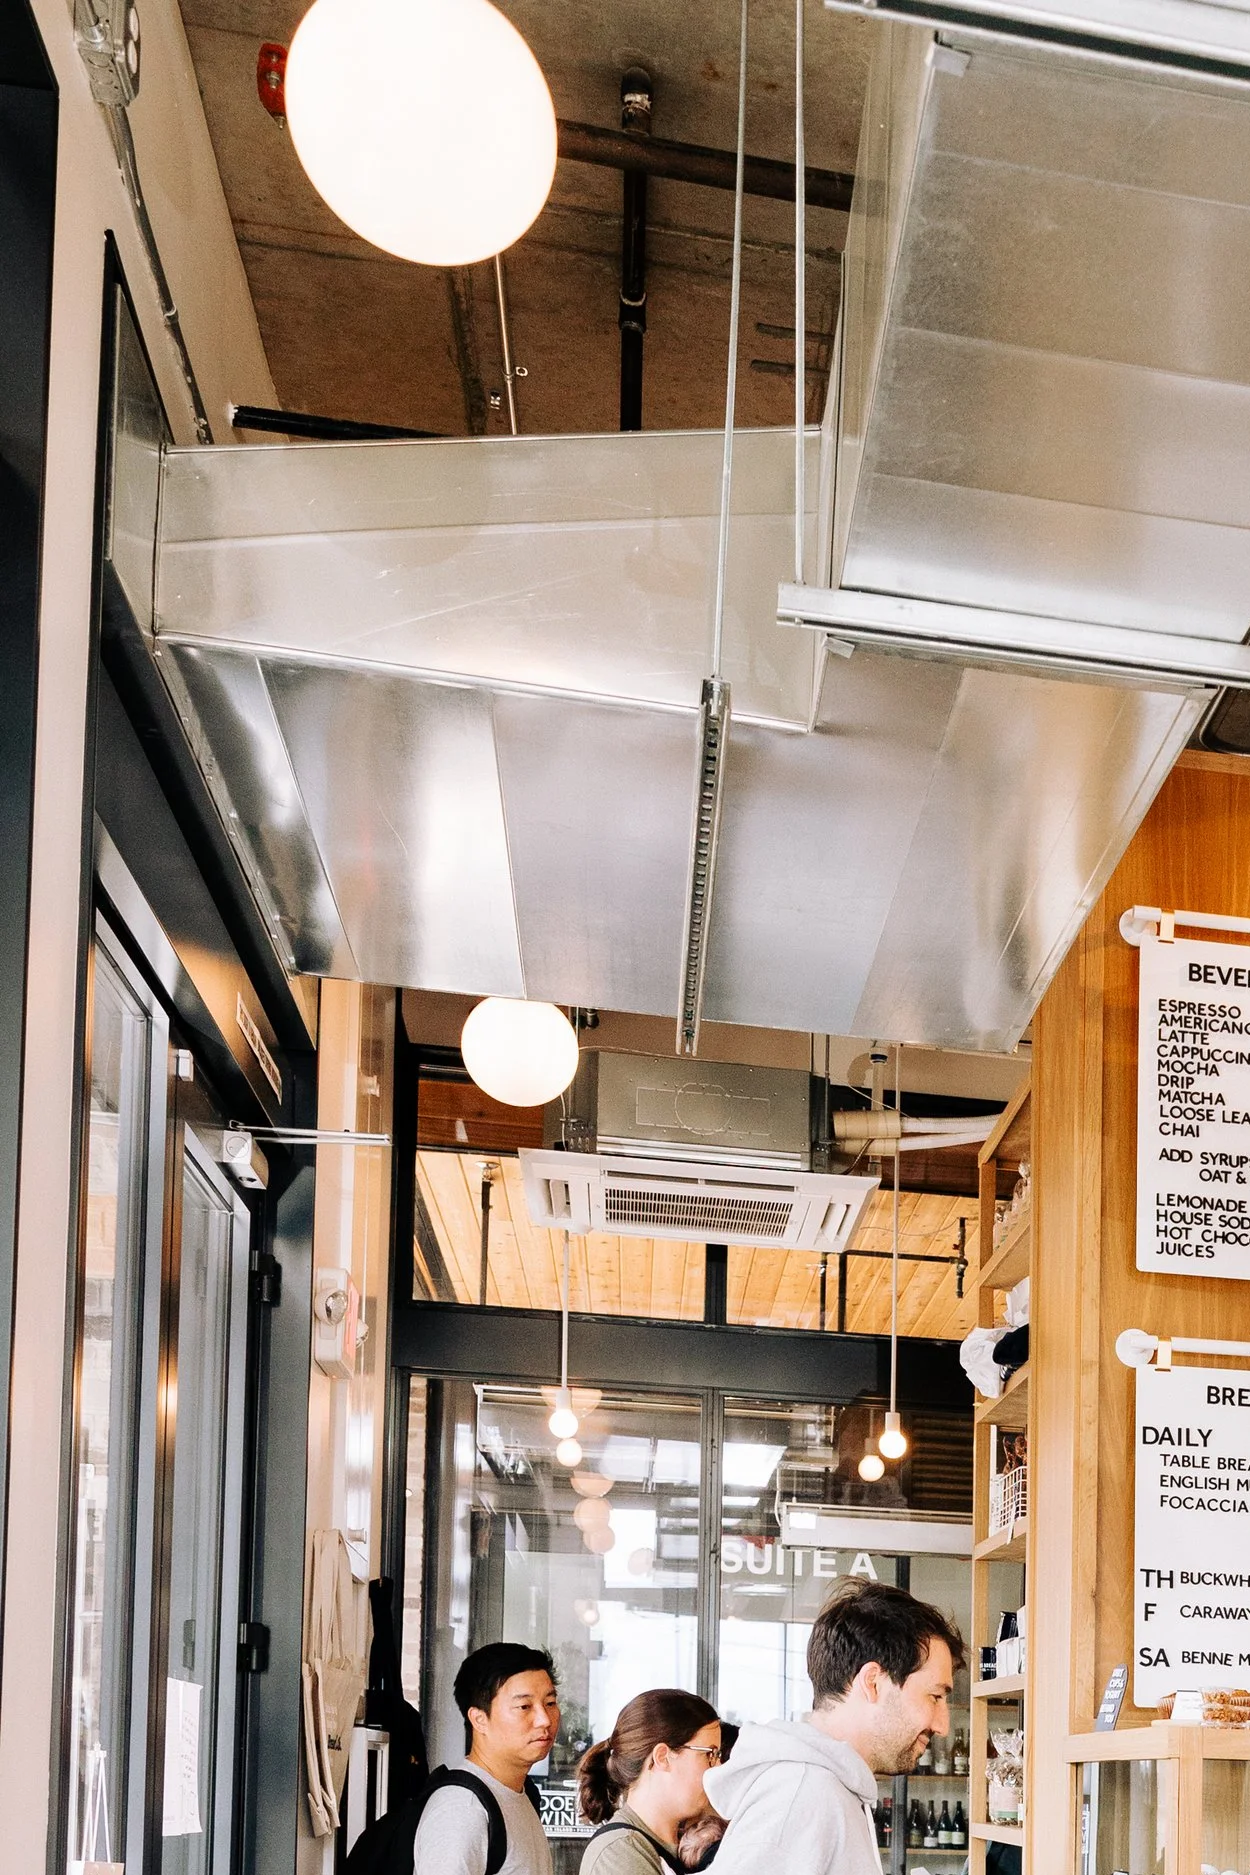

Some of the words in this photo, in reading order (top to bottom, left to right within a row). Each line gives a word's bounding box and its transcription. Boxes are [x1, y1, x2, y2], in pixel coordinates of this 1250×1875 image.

[1158, 999, 1241, 1019] ESPRESSO
[1158, 1028, 1209, 1045] LATTE
[1158, 1059, 1219, 1076] MOCHA
[1158, 1074, 1194, 1089] DRIP
[1158, 1089, 1225, 1106] MATCHA
[1160, 1105, 1215, 1122] LOOSE
[1159, 1122, 1199, 1138] CHAI
[1159, 1148, 1193, 1162] ADD
[1199, 1168, 1232, 1184] OAT
[1156, 1193, 1247, 1213] LEMONADE
[1156, 1209, 1213, 1226] HOUSE
[1156, 1224, 1192, 1240] HOT
[1156, 1242, 1214, 1258] JUICES
[1143, 1426, 1212, 1447] DAILY
[1160, 1454, 1210, 1469] TABLE
[1160, 1475, 1229, 1490] ENGLISH
[1160, 1495, 1248, 1512] FOCACCIA
[721, 1540, 838, 1578] SUITE
[850, 1552, 878, 1580] A
[1140, 1569, 1173, 1588] TH
[1144, 1603, 1156, 1621] F
[1140, 1648, 1170, 1667] SA
[1182, 1651, 1233, 1666] BENNE
